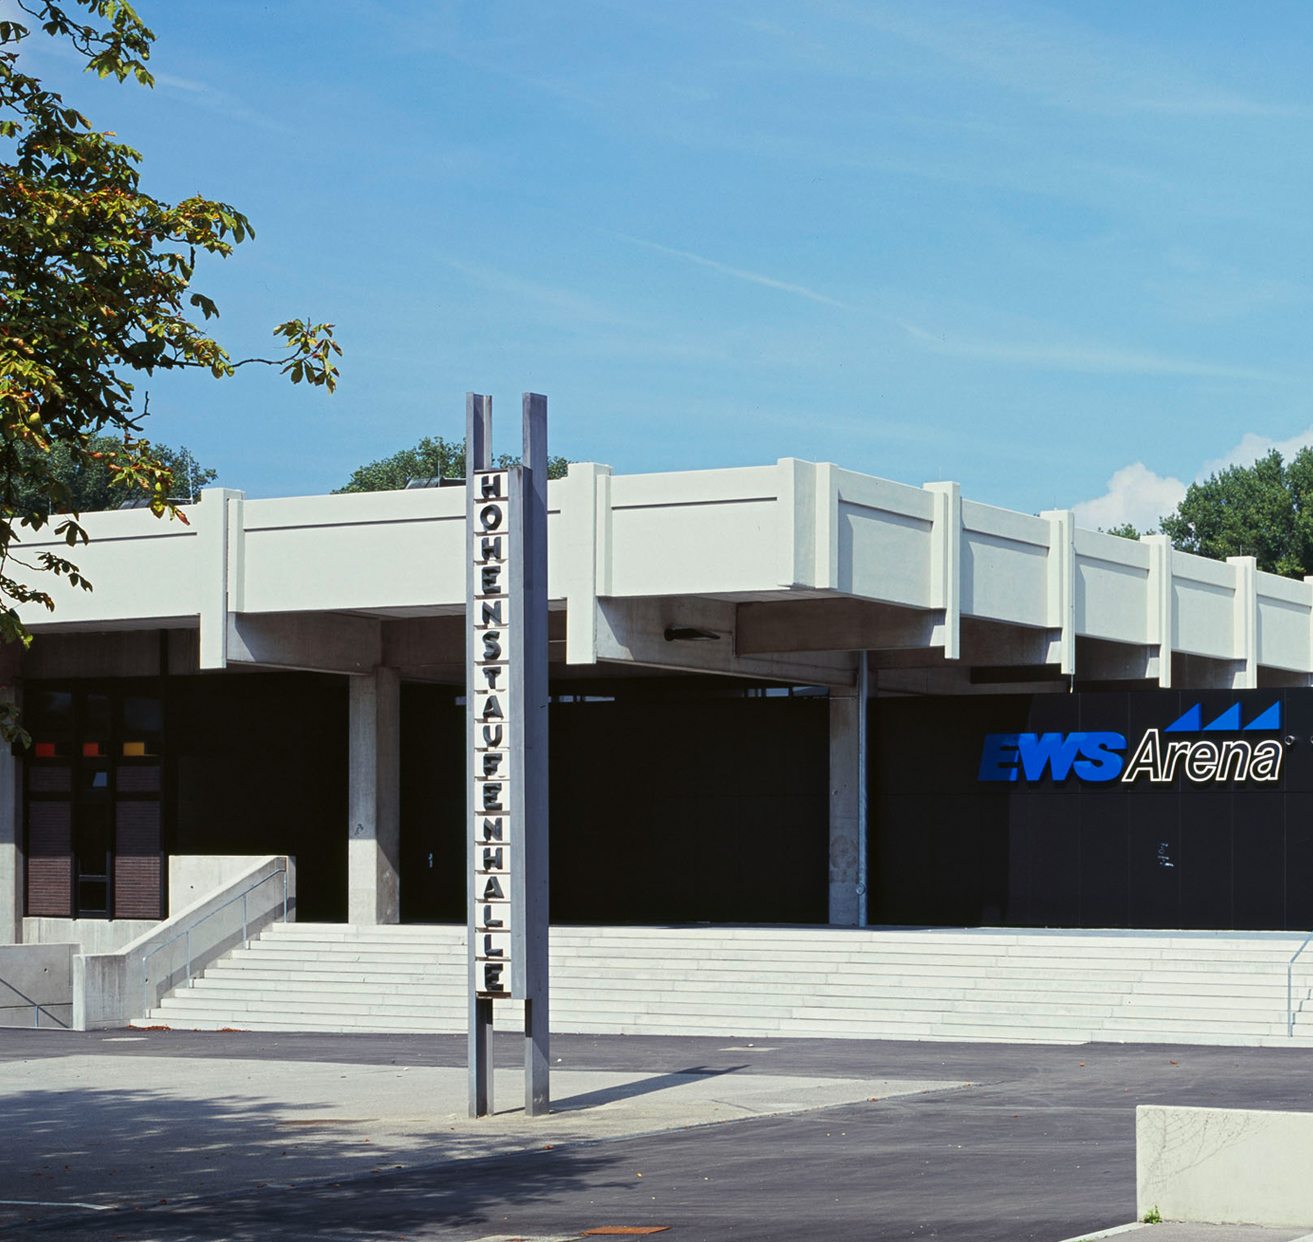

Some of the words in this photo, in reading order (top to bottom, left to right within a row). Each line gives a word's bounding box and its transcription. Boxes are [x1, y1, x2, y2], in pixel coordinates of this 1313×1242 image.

[480, 475, 505, 991] HOHENSTAUFENHALLE
[978, 732, 1127, 781] EWS
[1121, 729, 1283, 782] Arena
